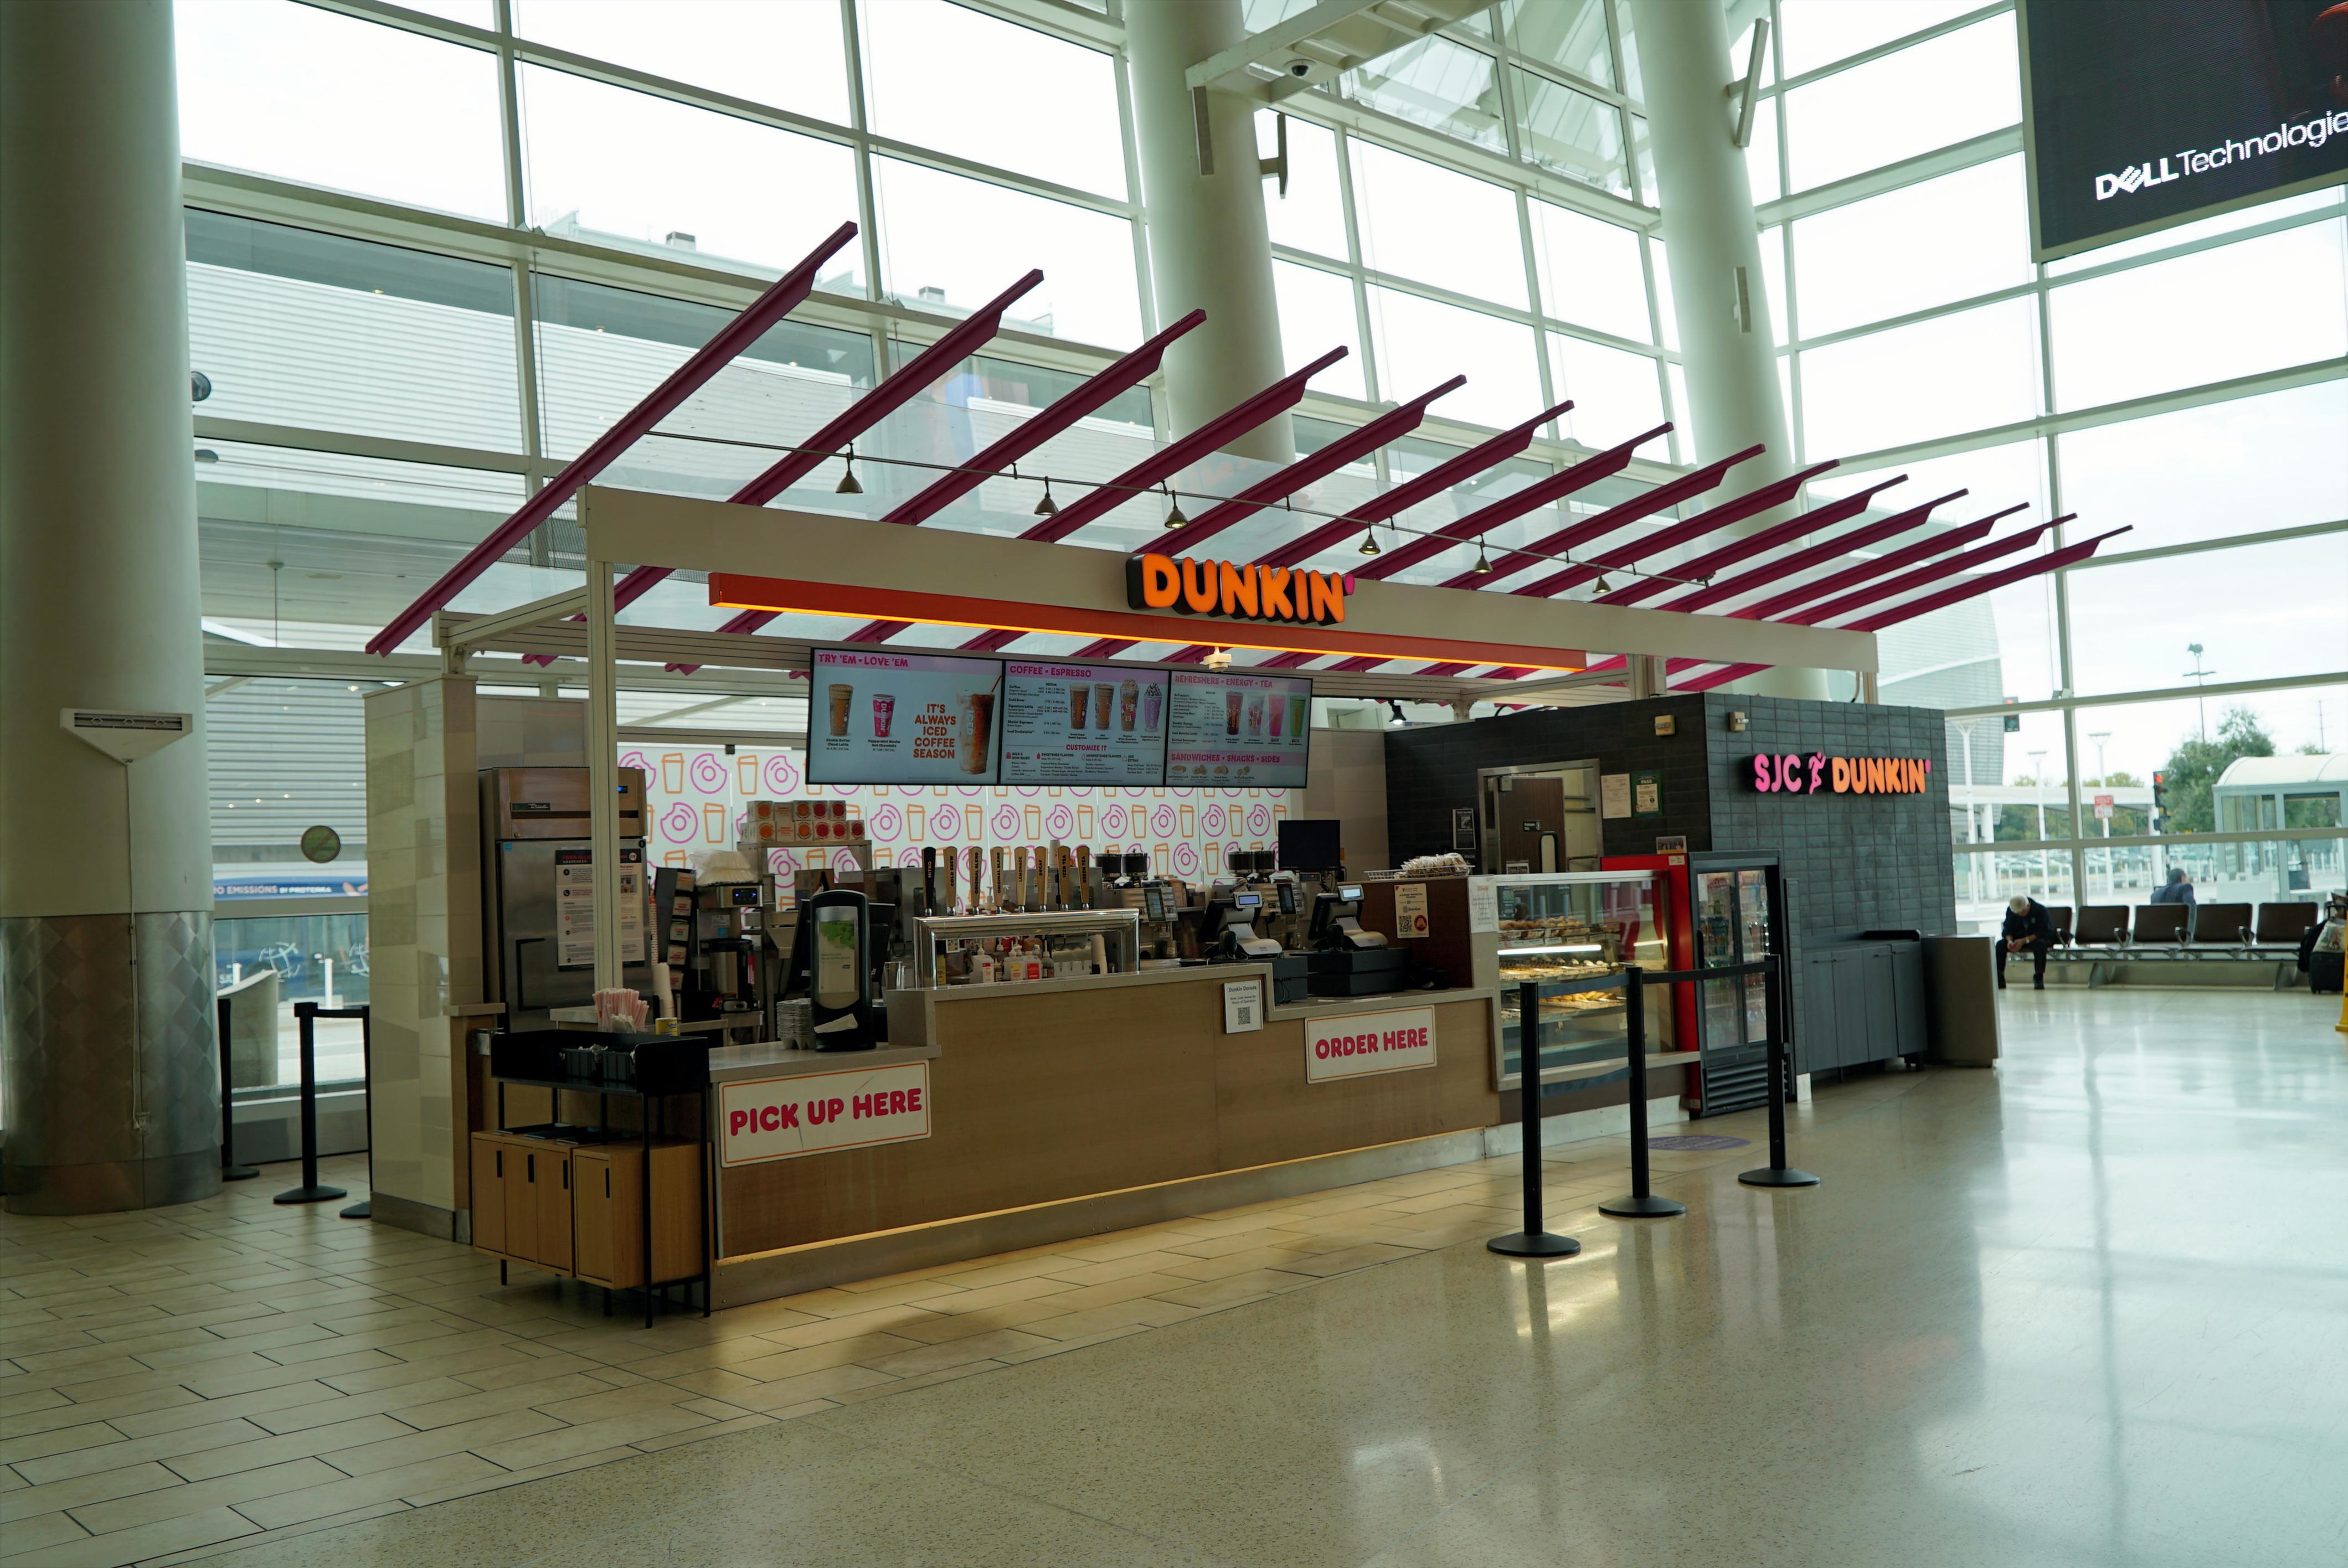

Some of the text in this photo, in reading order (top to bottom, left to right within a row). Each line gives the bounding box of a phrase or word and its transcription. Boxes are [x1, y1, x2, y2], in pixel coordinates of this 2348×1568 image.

[2095, 111, 2348, 200] DELL Technologie
[1141, 553, 1355, 623] DUNKIN'
[818, 653, 908, 667] TRY 'EM LOVE 'EM
[1010, 666, 1091, 678] COFFEE ESPRESSO
[1175, 675, 1273, 688] REFRESHERS ENERGY TEA
[927, 704, 945, 714] IT'S
[915, 714, 956, 725] ALWAYS
[923, 726, 948, 736] ICED
[914, 737, 955, 747] COFFEE
[913, 749, 955, 759] SEASON
[1171, 753, 1220, 761] SANDWICHES
[1227, 754, 1254, 762] SNACKS
[1754, 753, 1932, 794] SJC DUNKIN'
[226, 885, 279, 895] EMISSIONS
[1315, 1027, 1428, 1060] ORDER HERE
[730, 1087, 922, 1136] PICK UP HERE
